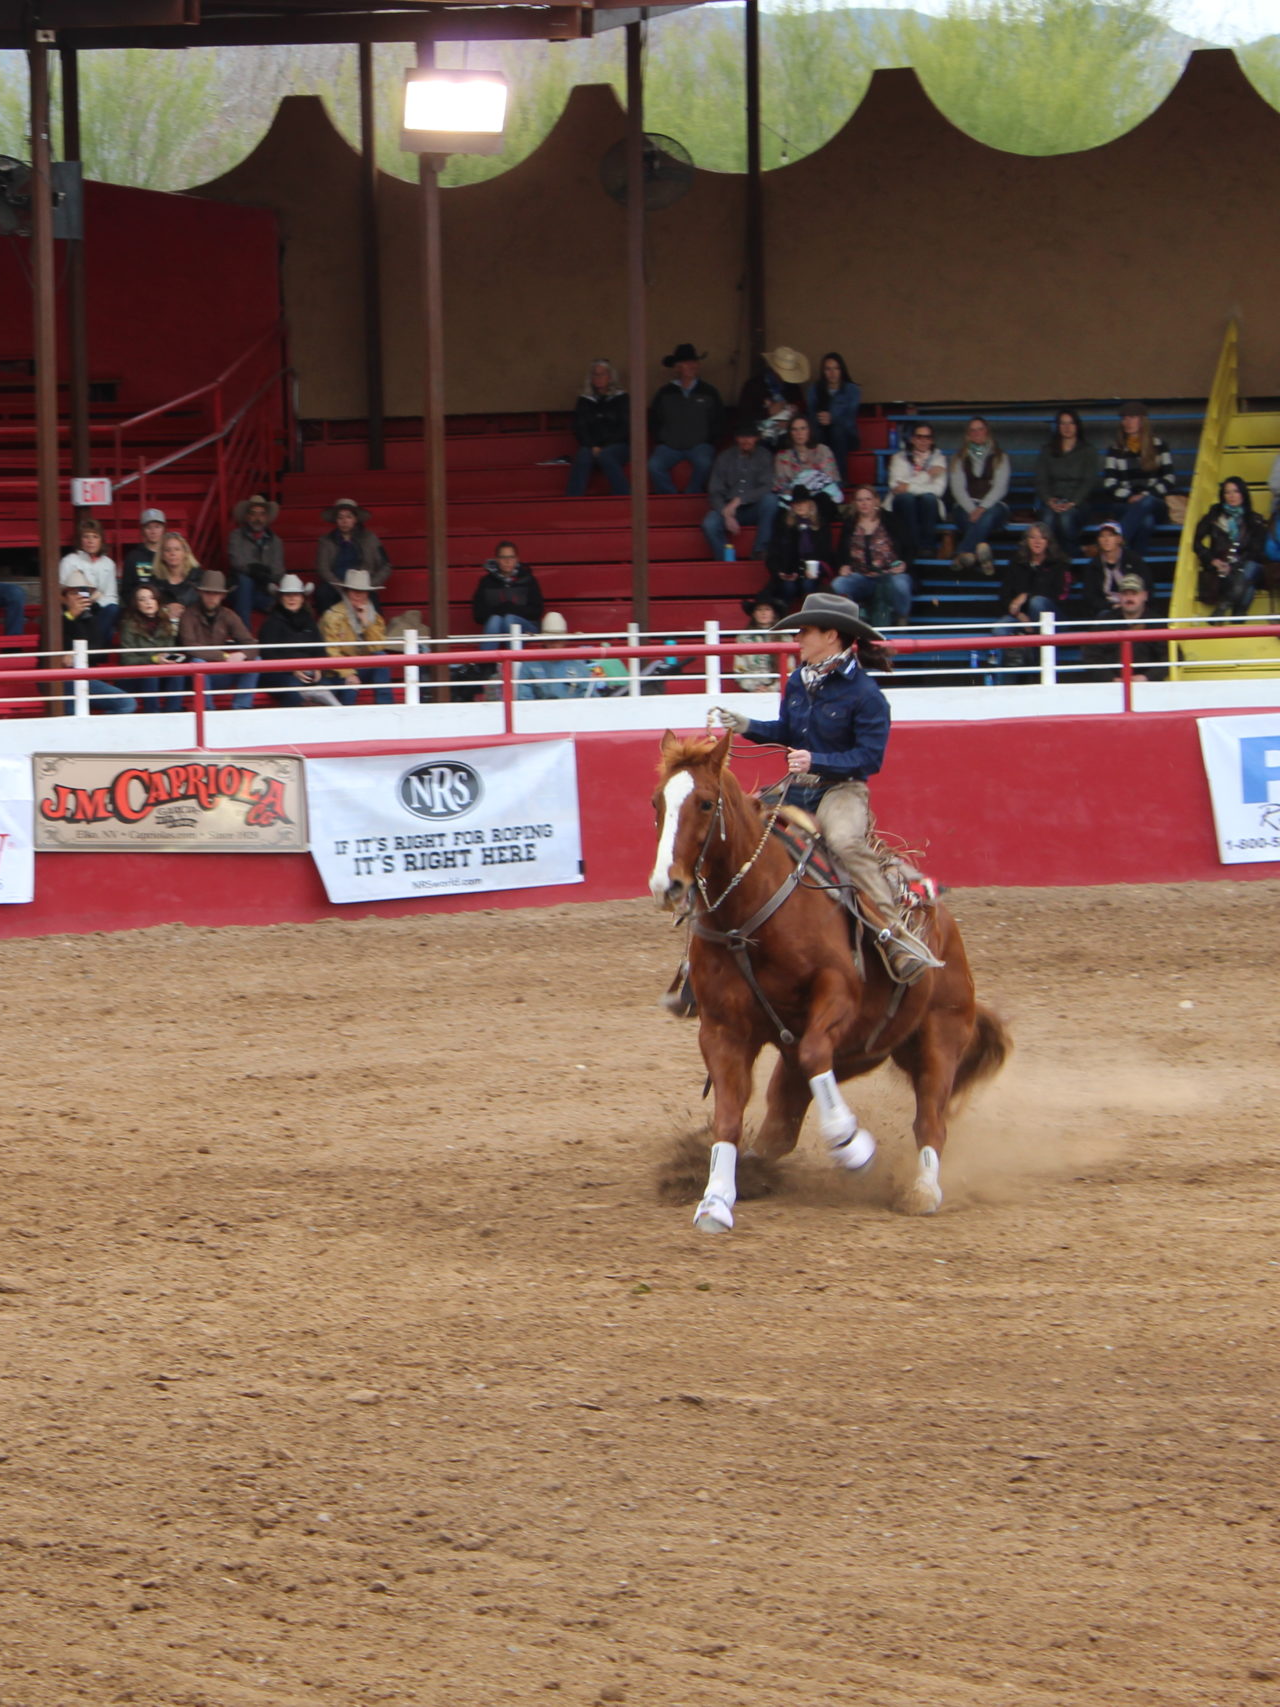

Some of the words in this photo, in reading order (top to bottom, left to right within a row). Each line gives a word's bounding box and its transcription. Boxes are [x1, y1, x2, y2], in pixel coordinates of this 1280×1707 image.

[113, 764, 294, 824] CAPRIOLA
[408, 767, 473, 813] NRS
[334, 840, 350, 855] IF
[356, 837, 388, 854] IT'S
[394, 832, 446, 850] RIGHT
[453, 830, 485, 846] FOR
[491, 823, 554, 843] ROPING
[353, 854, 396, 876] IT'S
[403, 848, 472, 872] RIGHT
[481, 843, 537, 866] HERE
